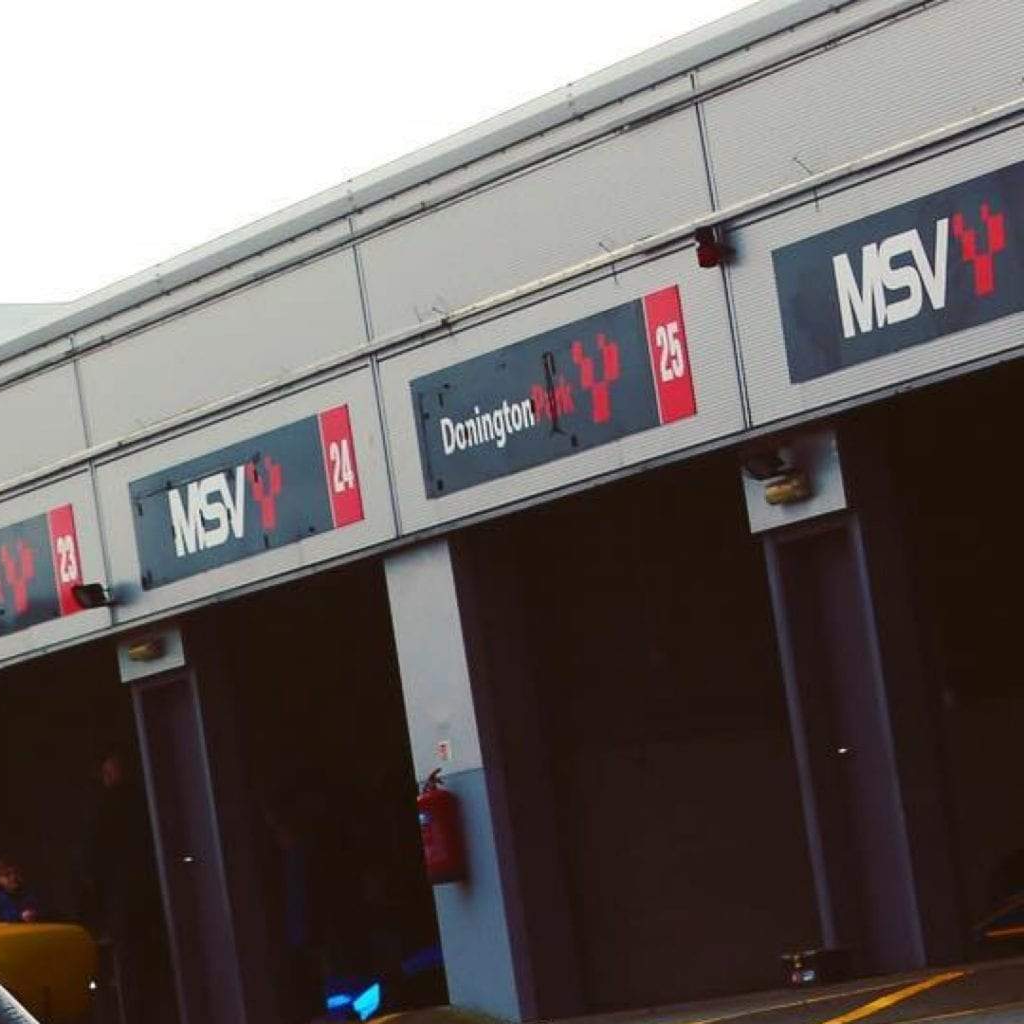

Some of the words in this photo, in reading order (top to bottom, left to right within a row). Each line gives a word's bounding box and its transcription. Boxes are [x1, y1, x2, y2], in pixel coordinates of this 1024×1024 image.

[833, 218, 949, 338] MSV
[656, 321, 685, 382] 25
[329, 440, 355, 492] 24
[168, 465, 246, 557] MSV
[57, 535, 78, 582] 23
